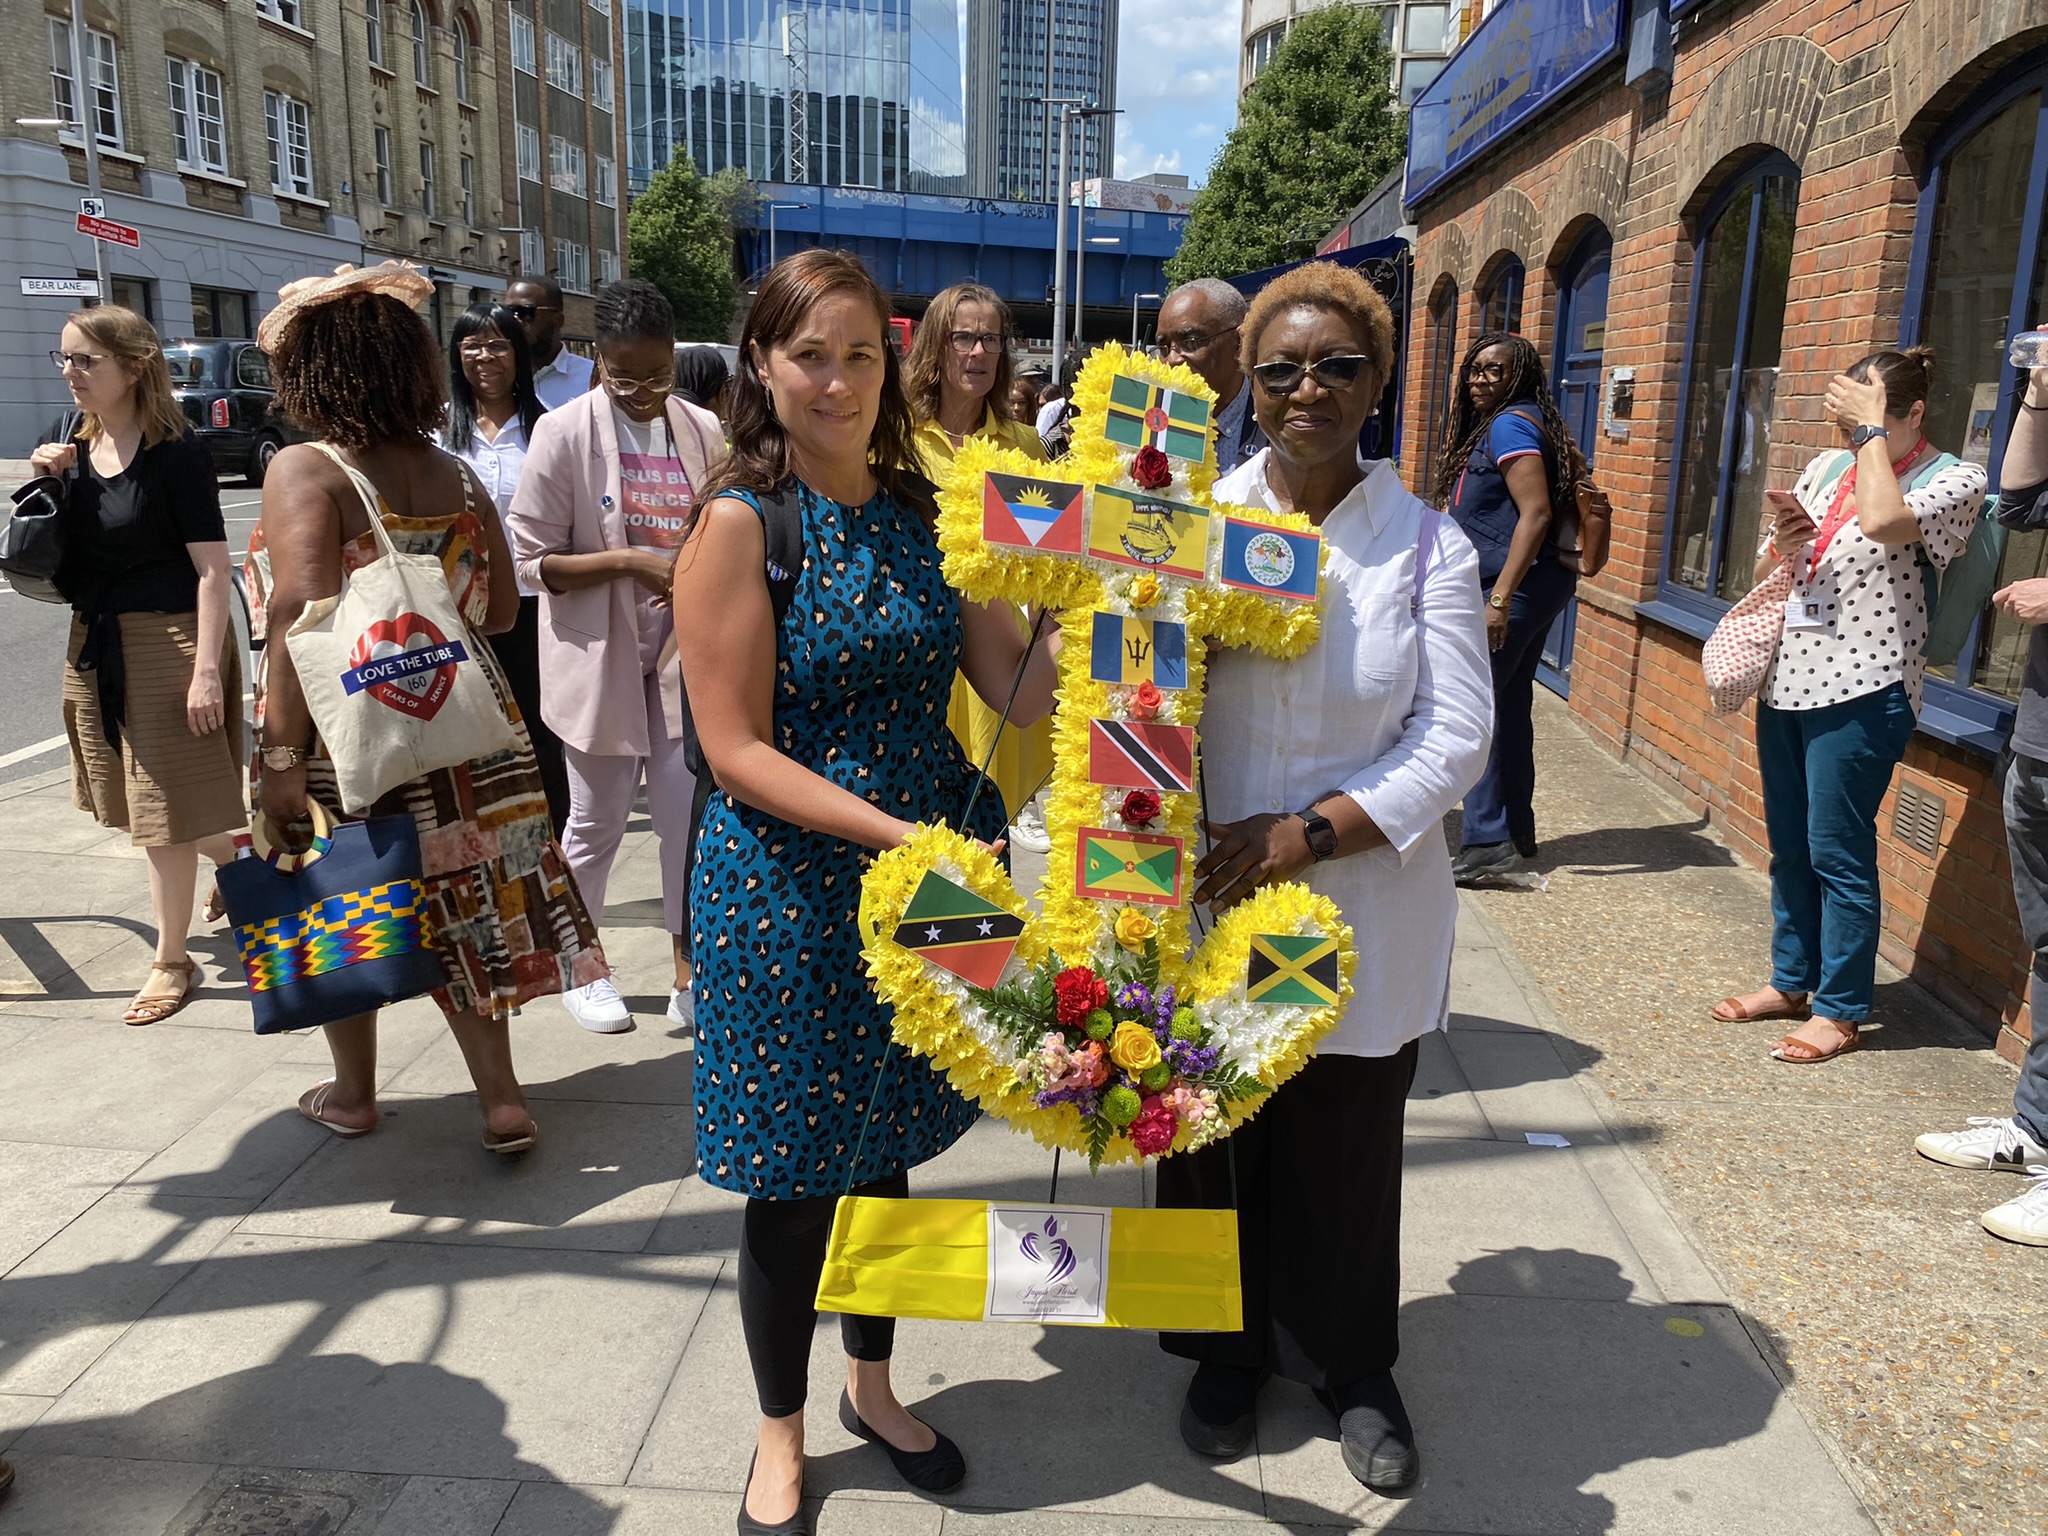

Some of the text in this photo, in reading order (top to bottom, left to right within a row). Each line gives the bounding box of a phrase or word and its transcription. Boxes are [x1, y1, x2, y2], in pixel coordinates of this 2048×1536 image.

[79, 223, 137, 245] Great Suffolk Street
[90, 219, 127, 236] No access to
[28, 281, 55, 290] BEAR
[57, 281, 82, 291] LANE
[631, 491, 690, 507] FENCE
[356, 647, 454, 684] LOVE THE TUBE
[382, 675, 447, 709] YEARS OF SERVICE
[407, 675, 427, 692] 160
